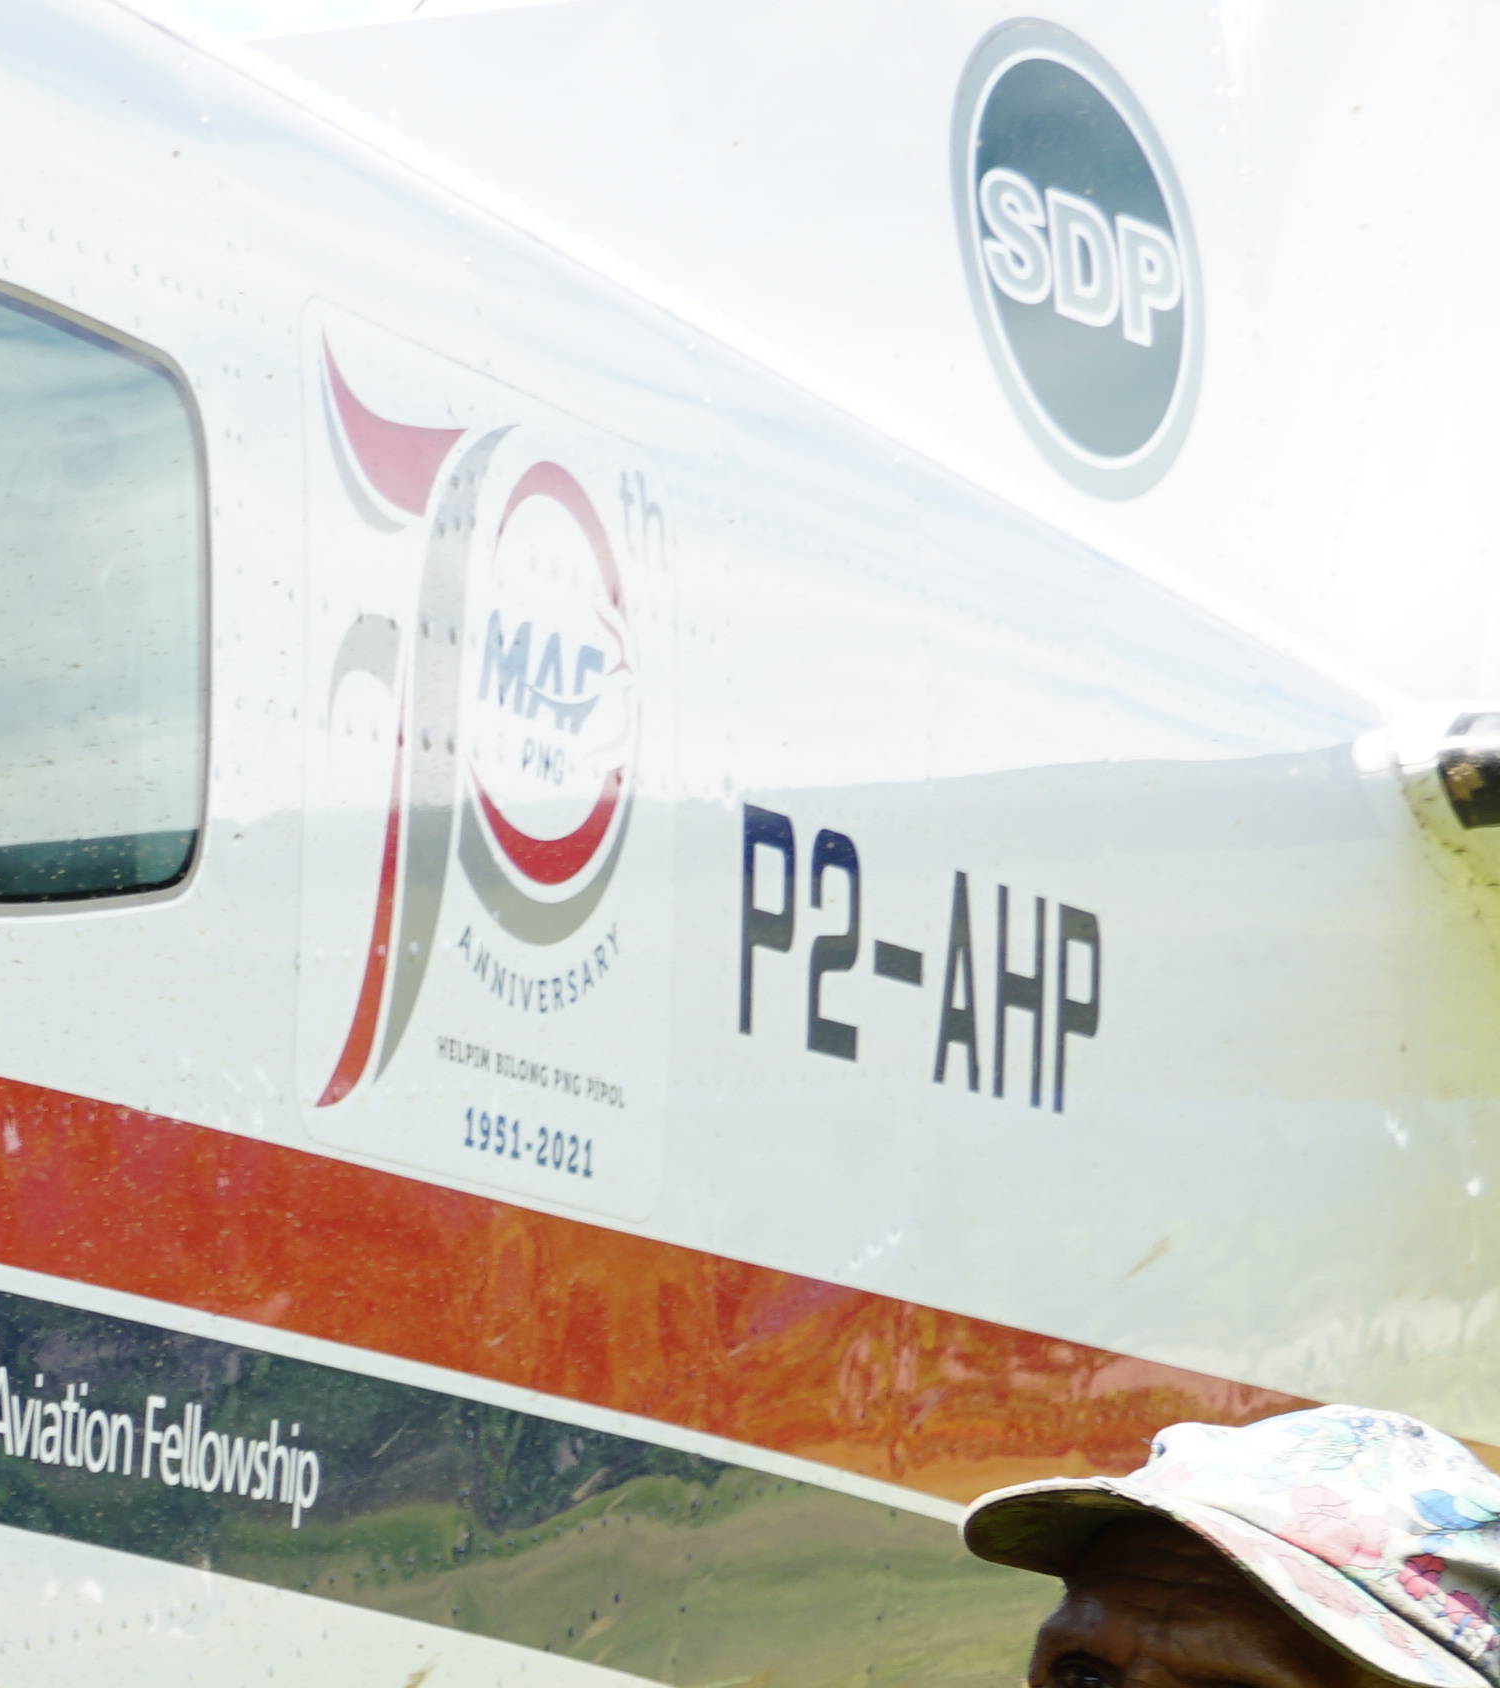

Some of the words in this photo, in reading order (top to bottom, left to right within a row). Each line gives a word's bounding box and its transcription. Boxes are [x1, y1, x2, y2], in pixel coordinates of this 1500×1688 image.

[980, 166, 1182, 347] SDP
[478, 609, 606, 736] MAF
[521, 736, 566, 787] PNG
[457, 920, 620, 1014] ANNIVERSARY
[738, 801, 1102, 1115] P2-AHP
[436, 1034, 491, 1072] HELPIM
[495, 1052, 548, 1088] BILONG
[553, 1067, 582, 1097] PNG
[462, 1105, 594, 1179] 1951-2021
[141, 1395, 322, 1530] Fellowship
